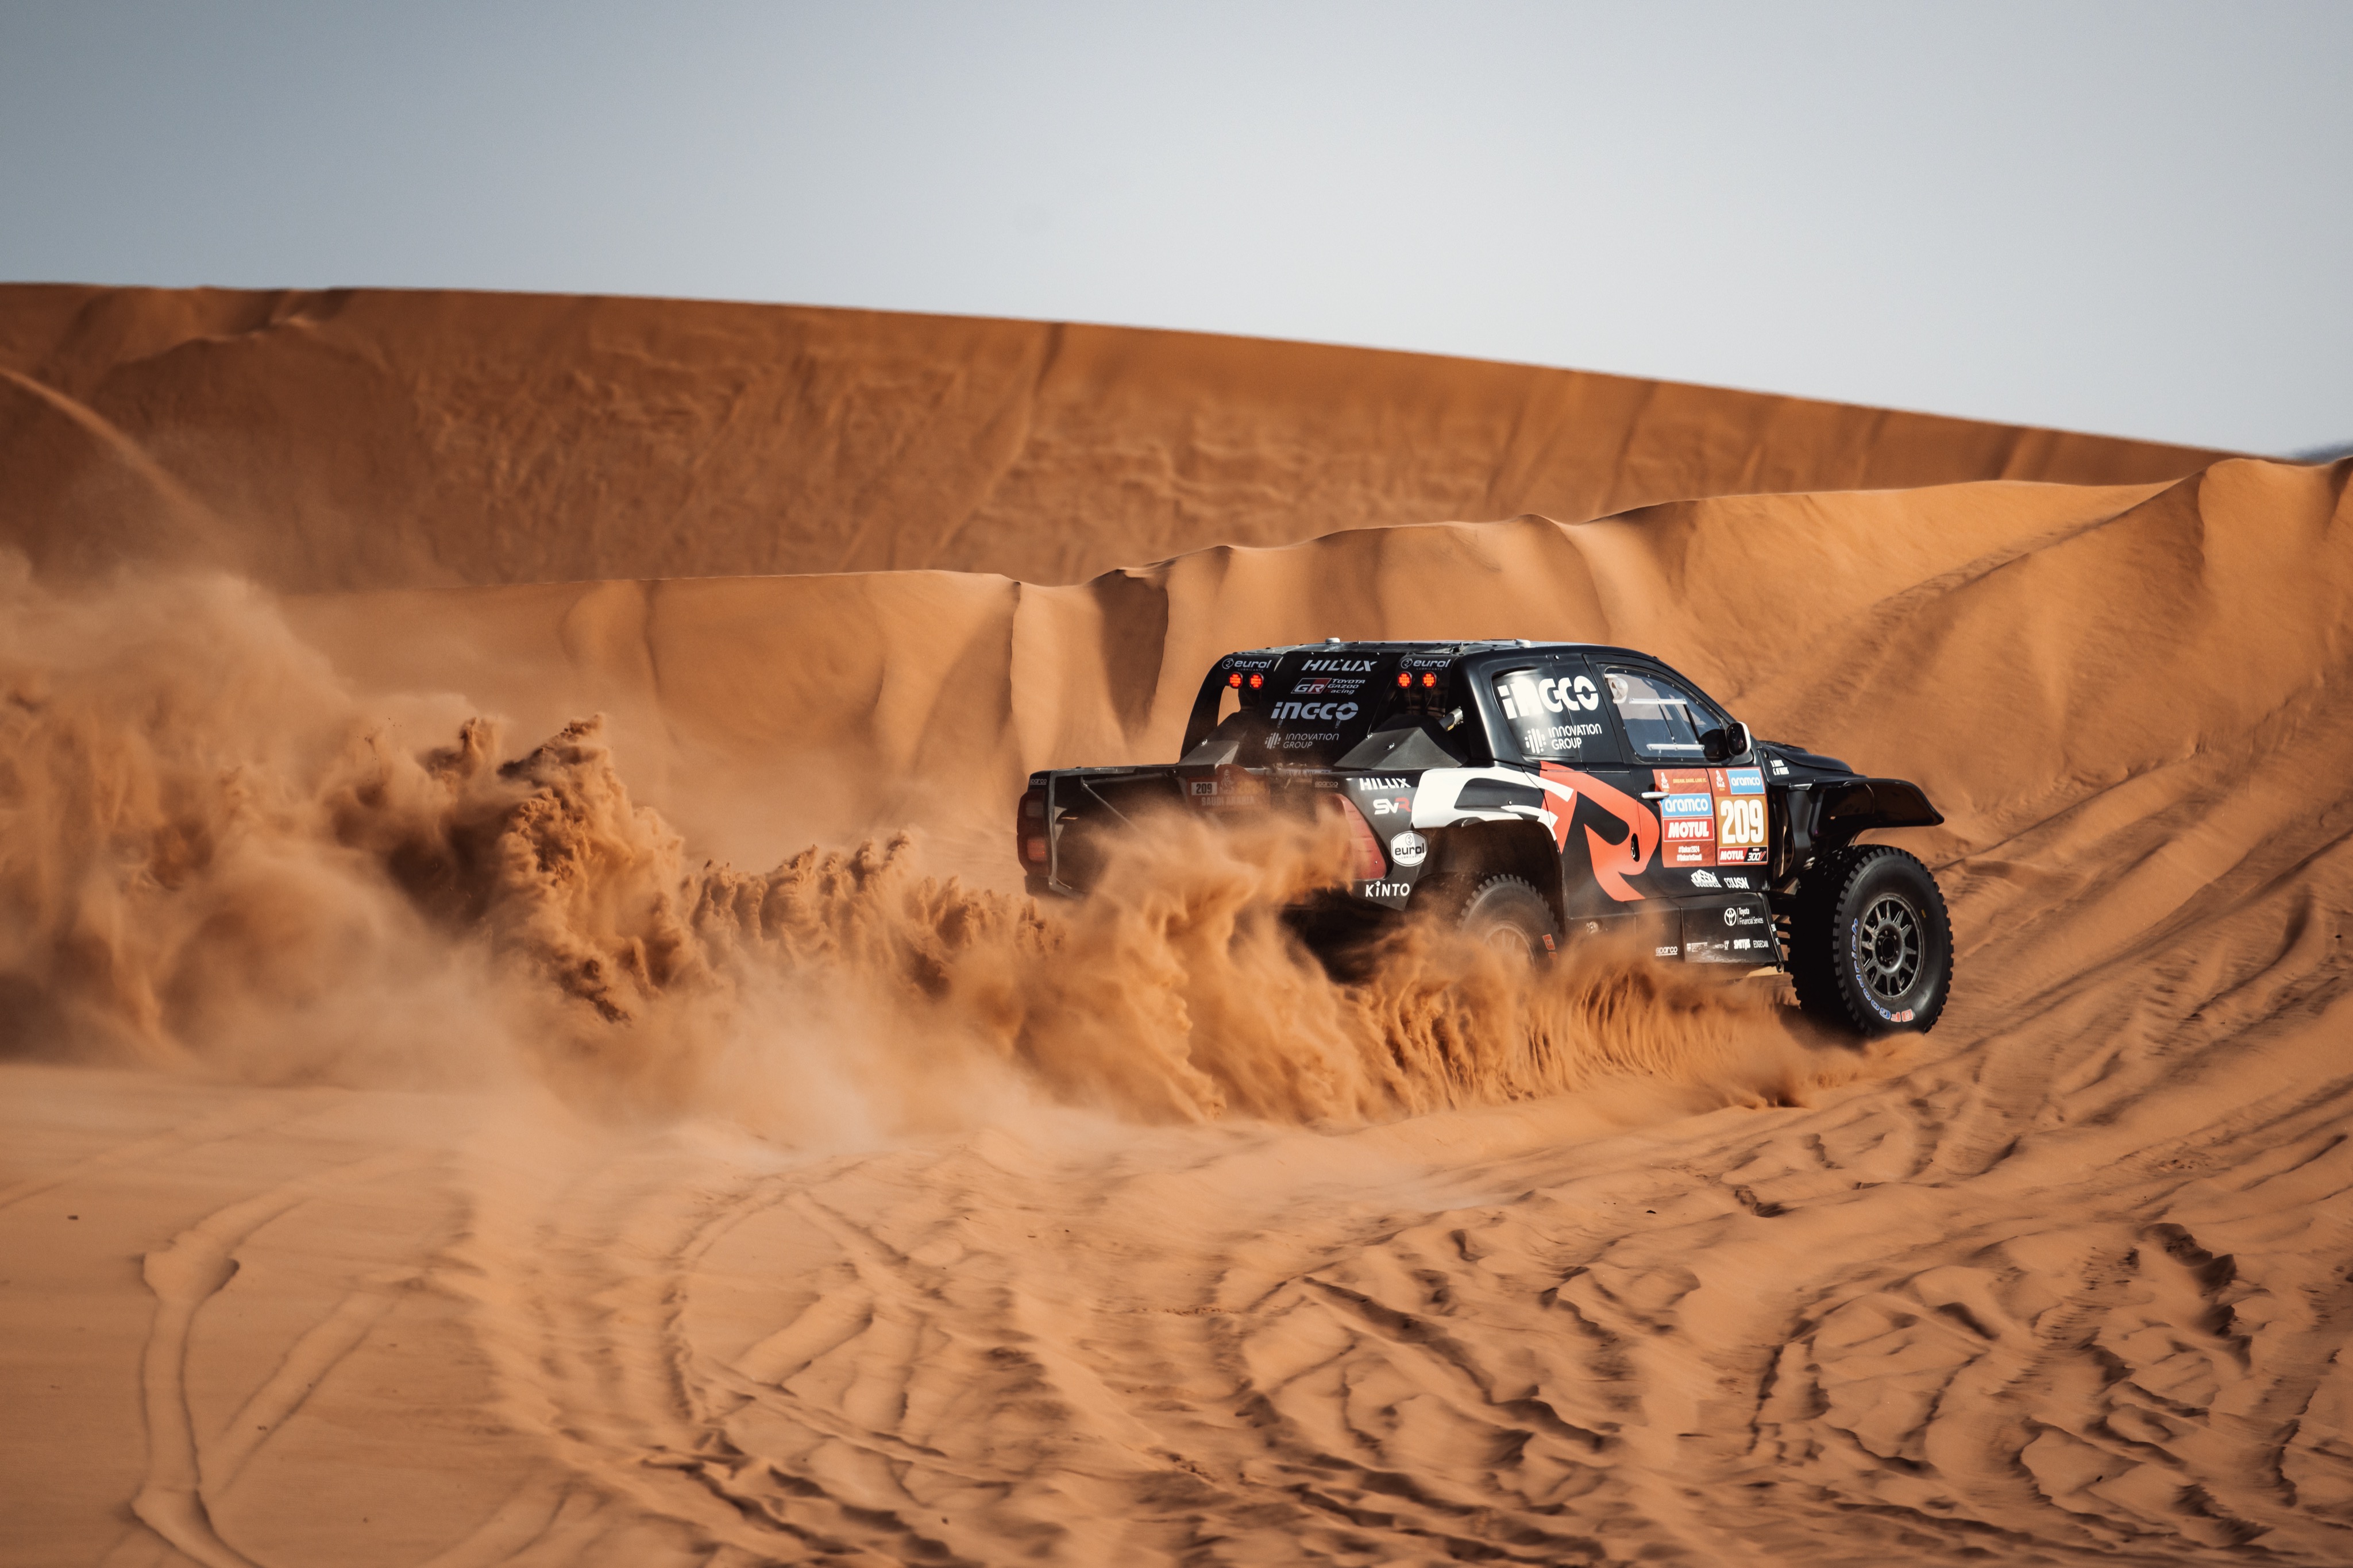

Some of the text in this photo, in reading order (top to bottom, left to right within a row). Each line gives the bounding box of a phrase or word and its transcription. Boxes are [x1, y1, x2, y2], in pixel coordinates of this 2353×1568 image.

[1234, 659, 1272, 669] eurol
[1301, 660, 1378, 671] HILUX
[1413, 659, 1451, 667] eurol
[1294, 683, 1325, 693] GR
[1548, 723, 1603, 737] INNOVATION
[1285, 733, 1340, 741] INNOVATION
[1552, 737, 1582, 750] GROUP
[1359, 778, 1411, 790] HILUX
[1731, 777, 1761, 786] aramco
[1196, 783, 1213, 794] 209
[1373, 797, 1412, 815] SVR
[1665, 798, 1708, 812] aramco
[1721, 799, 1764, 844] 209
[1668, 821, 1710, 838] MOTUL
[1395, 843, 1425, 856] eurol
[1720, 850, 1766, 861] MOTUL 300V
[1738, 907, 1750, 917] Toyota
[1739, 917, 1753, 925] Financial
[1656, 946, 1678, 957] sparco
